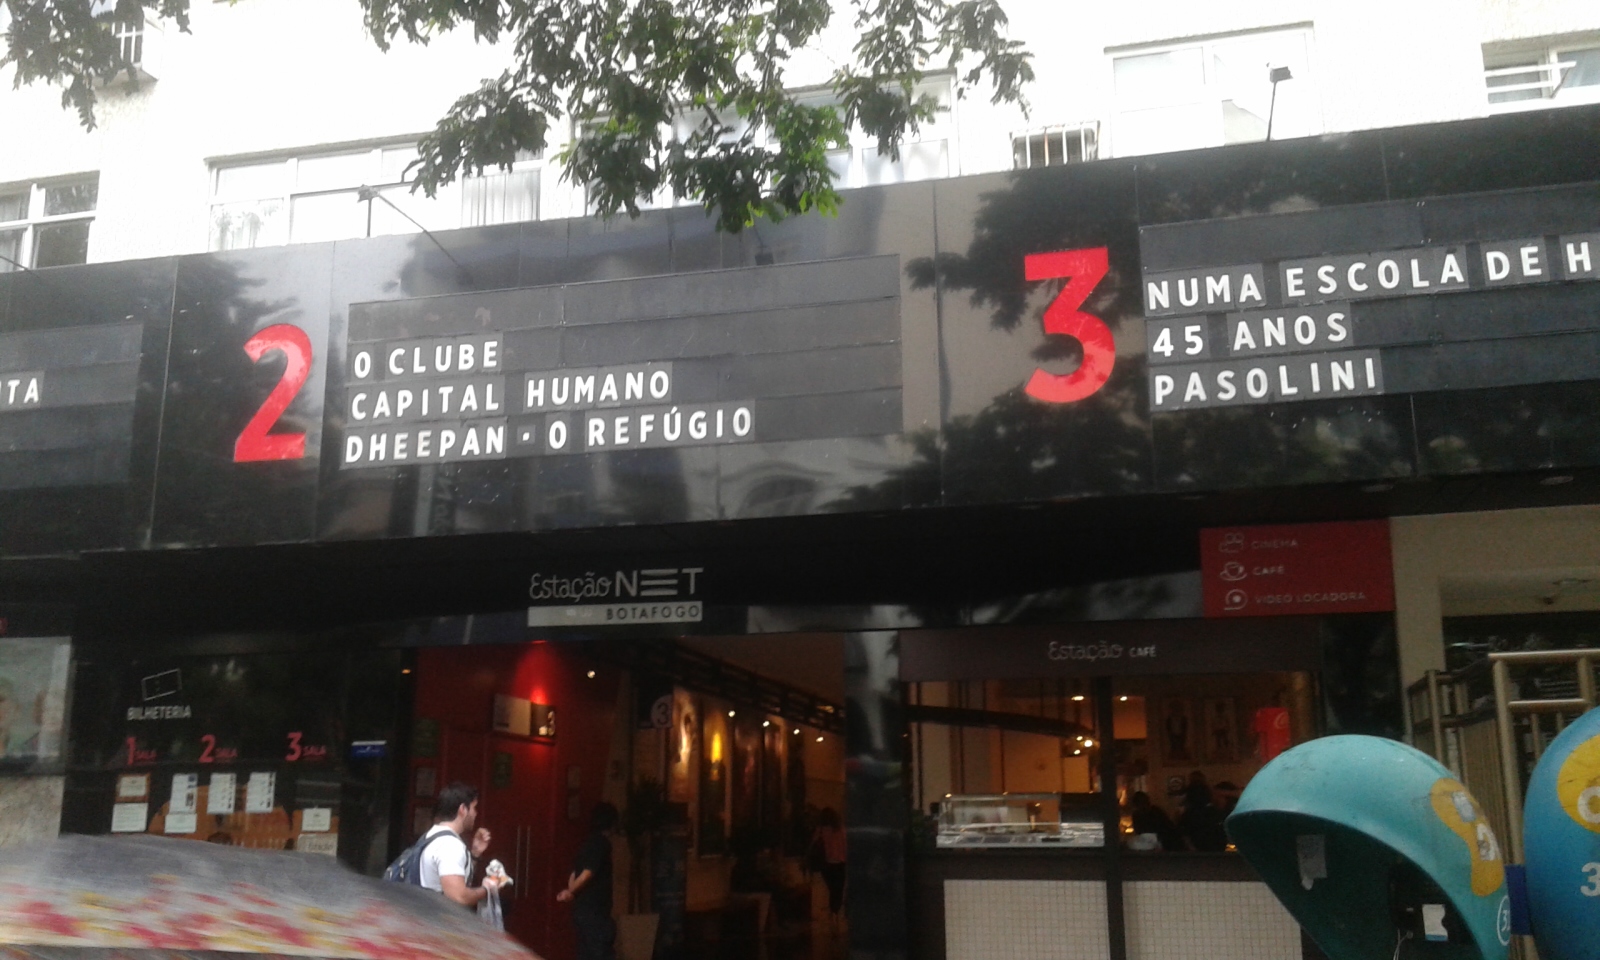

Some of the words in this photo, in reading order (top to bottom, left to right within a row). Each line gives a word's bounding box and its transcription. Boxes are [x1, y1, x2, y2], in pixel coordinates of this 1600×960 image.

[1147, 273, 1262, 310] NUMA
[1286, 253, 1466, 298] ESCOLA
[1486, 246, 1543, 281] DE
[1024, 247, 1116, 403] 3
[1153, 325, 1203, 357] 45
[1233, 312, 1347, 351] ANOS
[354, 351, 372, 378] O
[388, 340, 498, 375] CLUBE
[0, 377, 39, 405] TA
[233, 323, 312, 463] 2
[351, 383, 499, 420] CAPITAL
[527, 370, 670, 408] HUMANO
[1154, 357, 1377, 404] PASOLINI
[345, 425, 505, 463] DHEEPAN
[549, 421, 567, 449] O
[588, 406, 751, 446] REFÚGIO
[1252, 539, 1299, 550] CINEMA
[529, 571, 612, 602] Estação
[615, 567, 704, 597] NET
[606, 605, 700, 621] BOTAFOGO
[1048, 640, 1123, 662] Estação
[127, 705, 192, 720] BILHETERIA
[126, 737, 137, 765] 1
[198, 734, 216, 763] 2
[285, 732, 303, 761] 3
